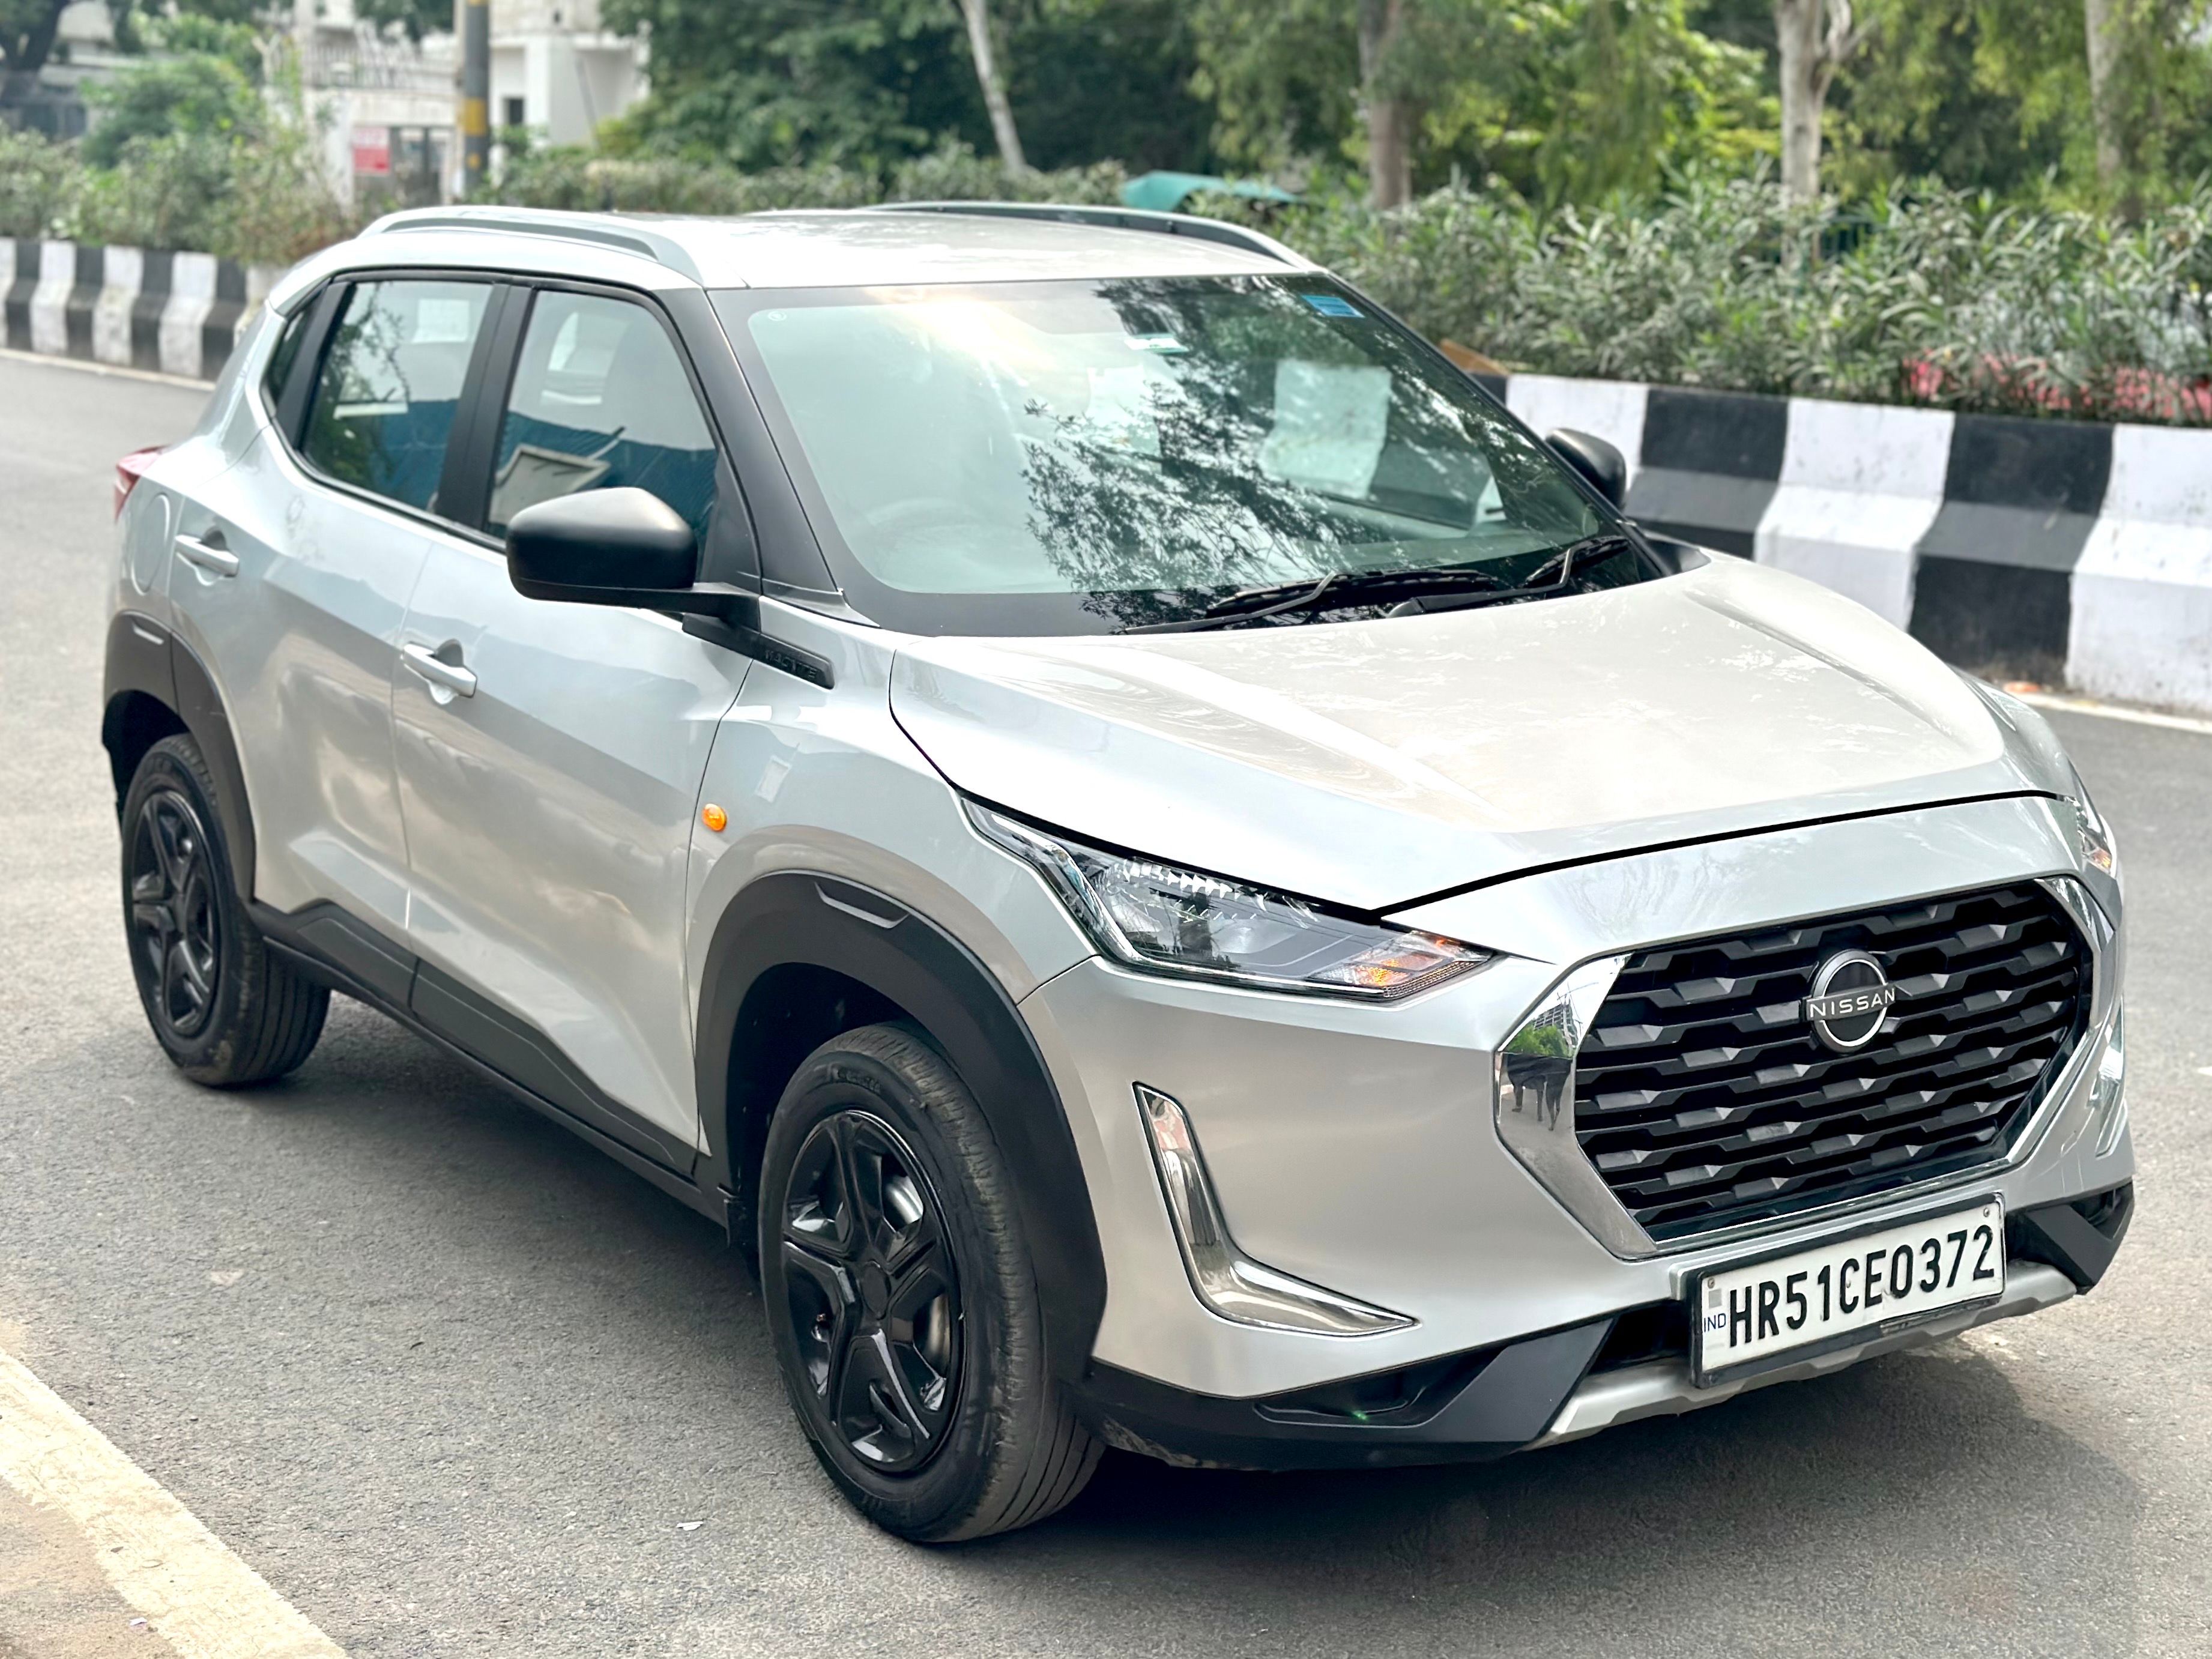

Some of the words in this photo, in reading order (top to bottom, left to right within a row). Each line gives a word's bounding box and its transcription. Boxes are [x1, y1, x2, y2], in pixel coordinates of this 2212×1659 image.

[1810, 988, 1895, 1018] NISSAN
[1730, 1224, 1995, 1347] HR51CE0372
[1703, 1313, 1727, 1333] IND
